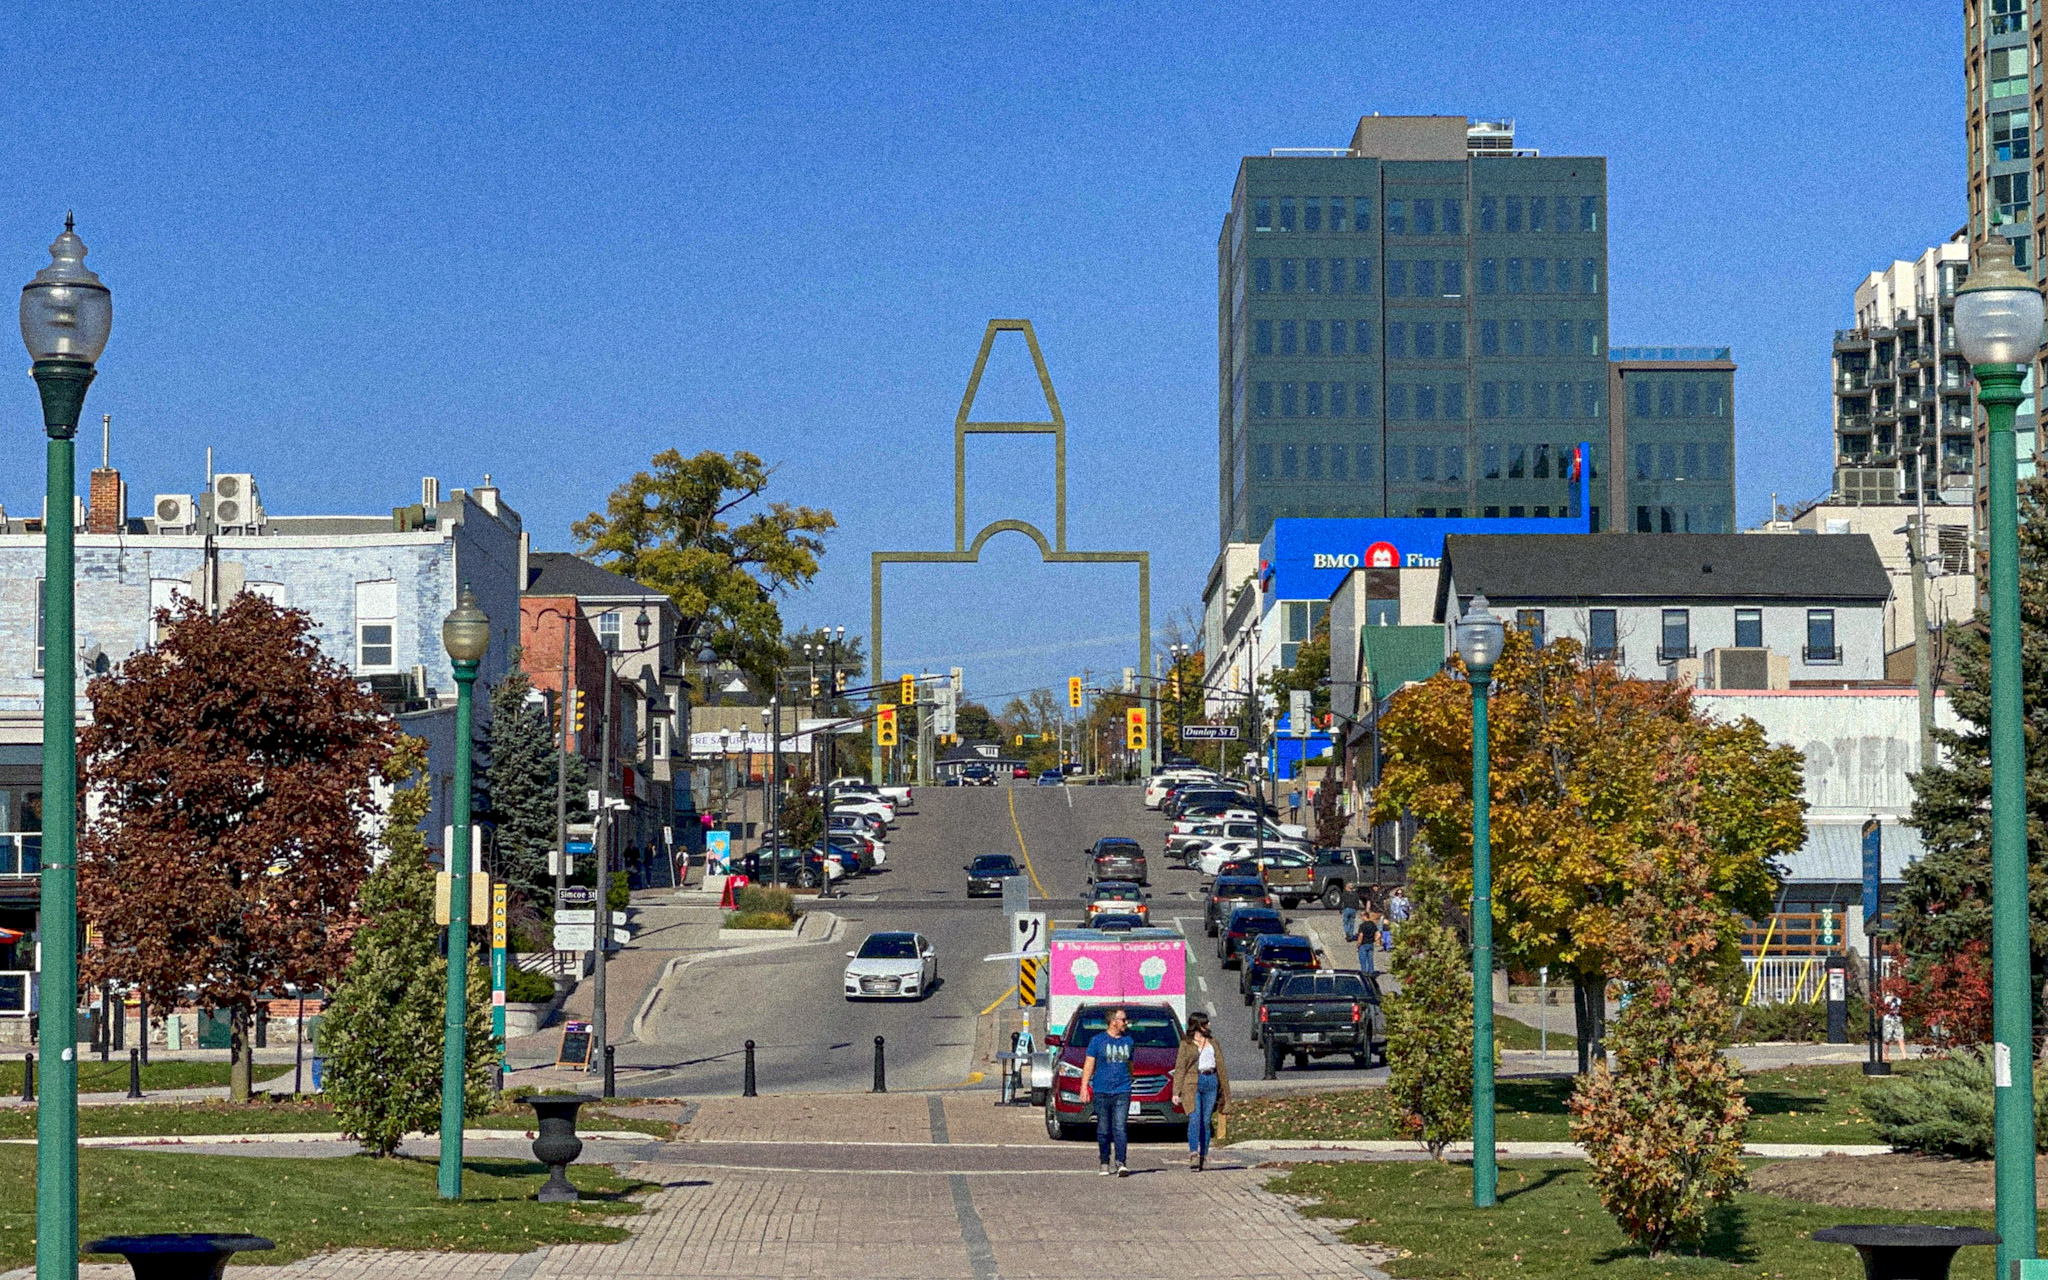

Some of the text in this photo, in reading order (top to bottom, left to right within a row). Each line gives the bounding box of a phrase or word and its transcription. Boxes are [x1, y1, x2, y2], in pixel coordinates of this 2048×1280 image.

[1314, 553, 1359, 568] BMO
[1186, 729, 1217, 738] Dunlop
[1218, 729, 1229, 737] St
[561, 891, 595, 899] Simcoe St
[496, 894, 504, 941] PARK
[1068, 942, 1082, 950] The
[1084, 942, 1121, 951] Awesome
[1123, 942, 1157, 952] Cupcake
